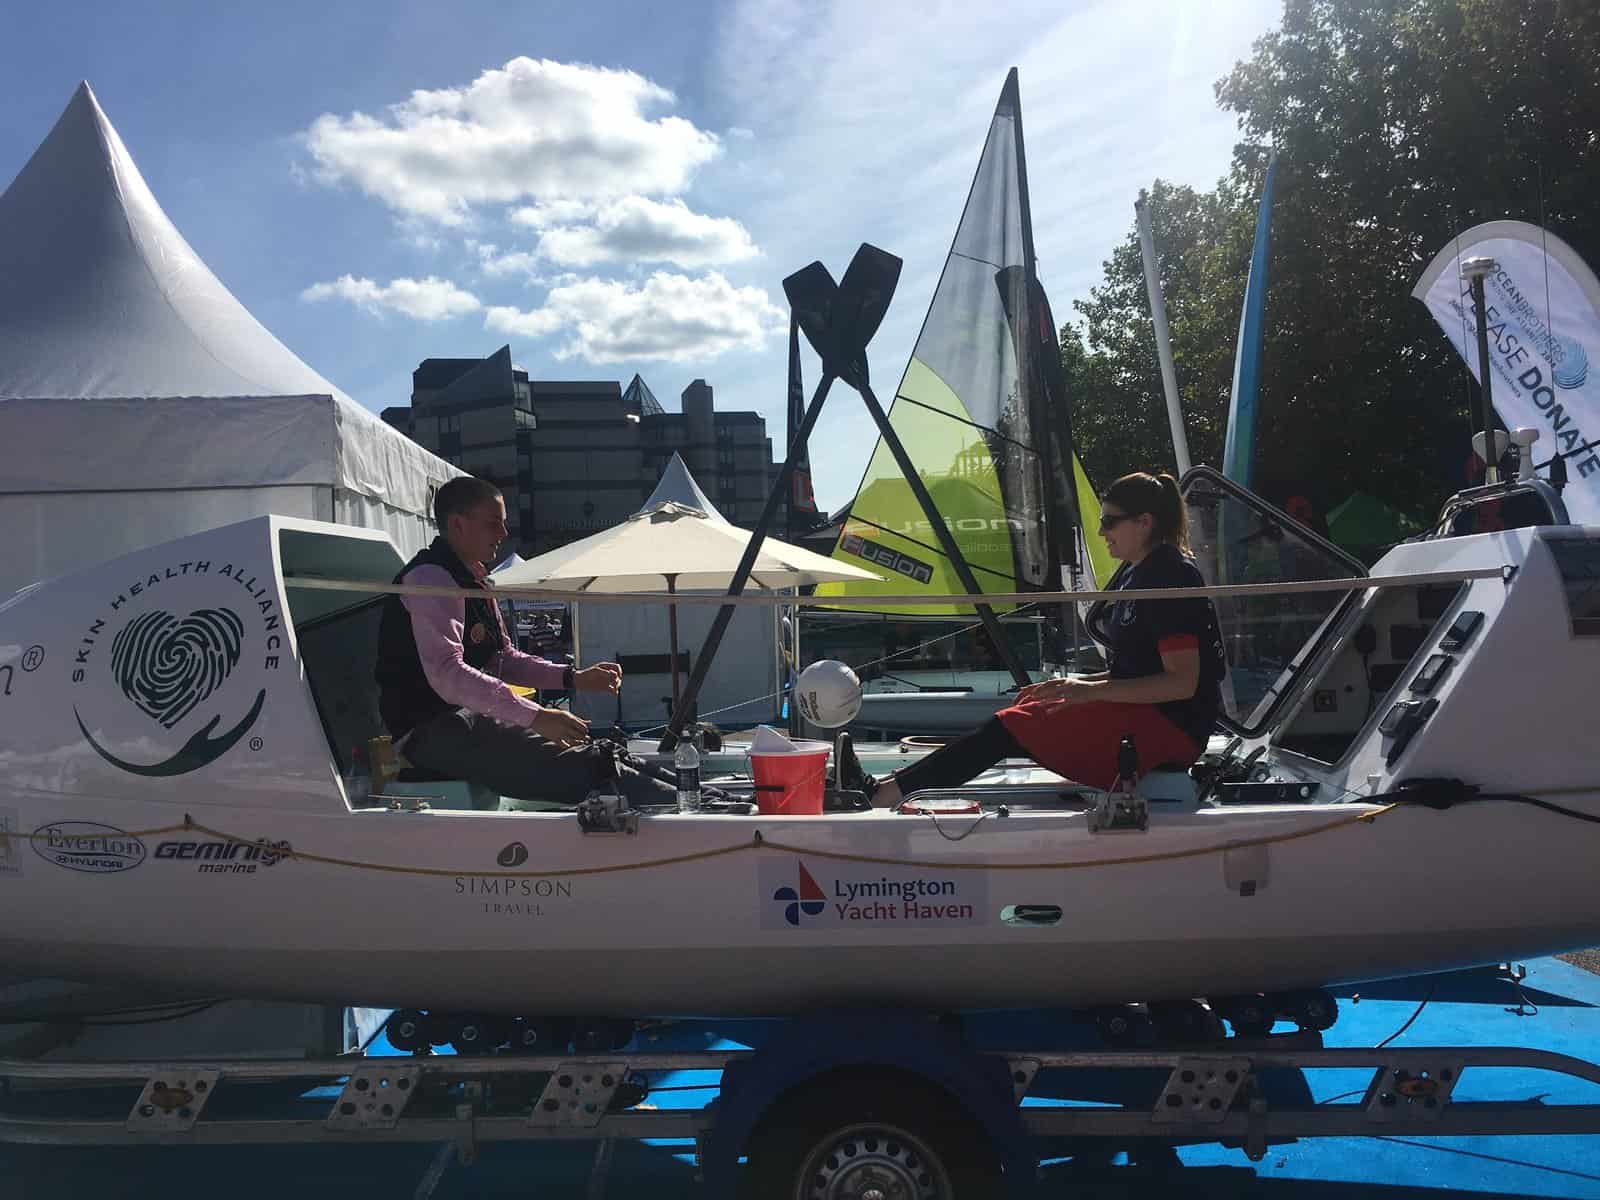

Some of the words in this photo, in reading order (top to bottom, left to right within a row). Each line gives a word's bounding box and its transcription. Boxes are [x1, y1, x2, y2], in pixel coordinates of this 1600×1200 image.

[72, 618, 105, 682] SKIN
[111, 560, 211, 610] HEALTH
[219, 563, 281, 670] ALLIANCE
[48, 828, 140, 856] Everton
[198, 863, 257, 873] marine
[456, 877, 571, 897] SIMPSON
[835, 877, 955, 901] Lymington
[482, 903, 544, 916] TRAVEL
[835, 903, 897, 920] Yacht
[904, 902, 972, 920] Haven
